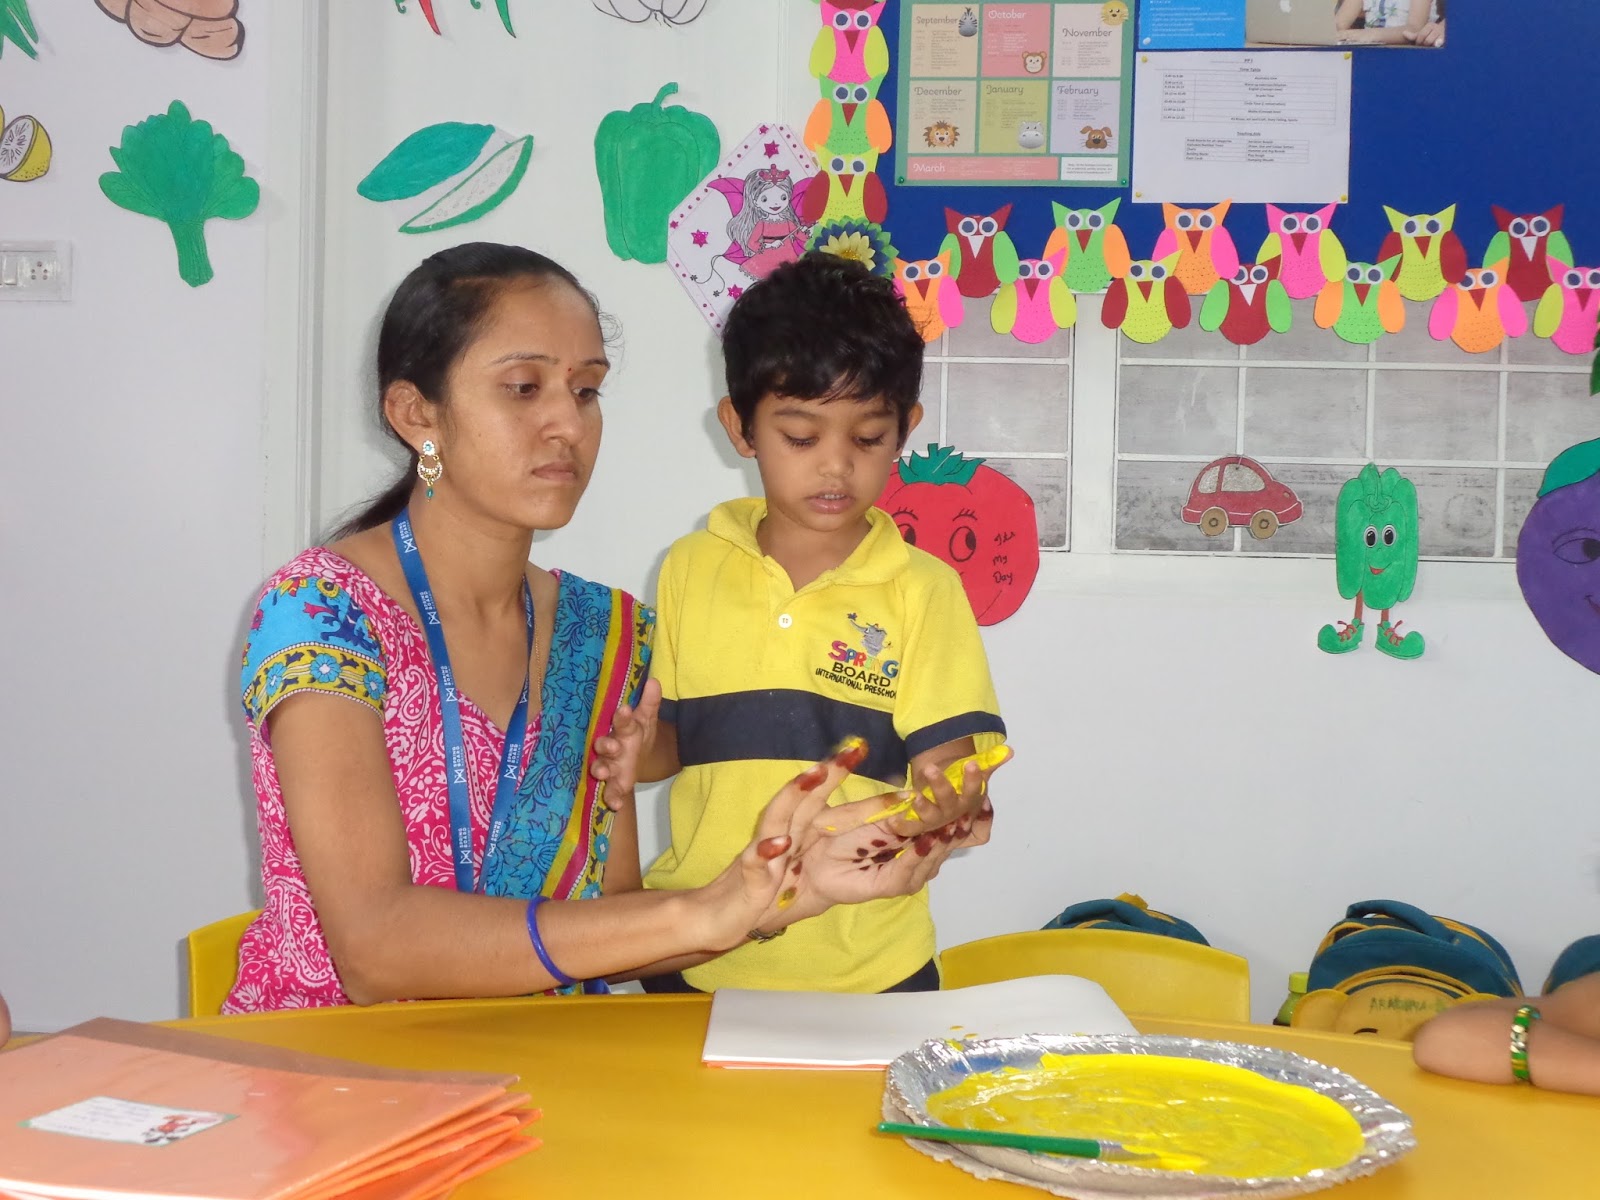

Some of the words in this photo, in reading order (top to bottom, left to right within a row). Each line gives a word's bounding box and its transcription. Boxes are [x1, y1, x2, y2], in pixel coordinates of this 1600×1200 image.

[988, 10, 1027, 20] October
[915, 15, 958, 27] September
[1062, 28, 1112, 38] November
[914, 87, 962, 96] December
[986, 85, 1024, 96] January
[1056, 85, 1099, 96] February
[913, 163, 946, 173] March
[992, 554, 1008, 566] My
[992, 570, 1013, 585] Day
[828, 640, 899, 679] SPRING
[815, 667, 863, 691] INTERNATIONAL
[832, 661, 891, 688] BOARD
